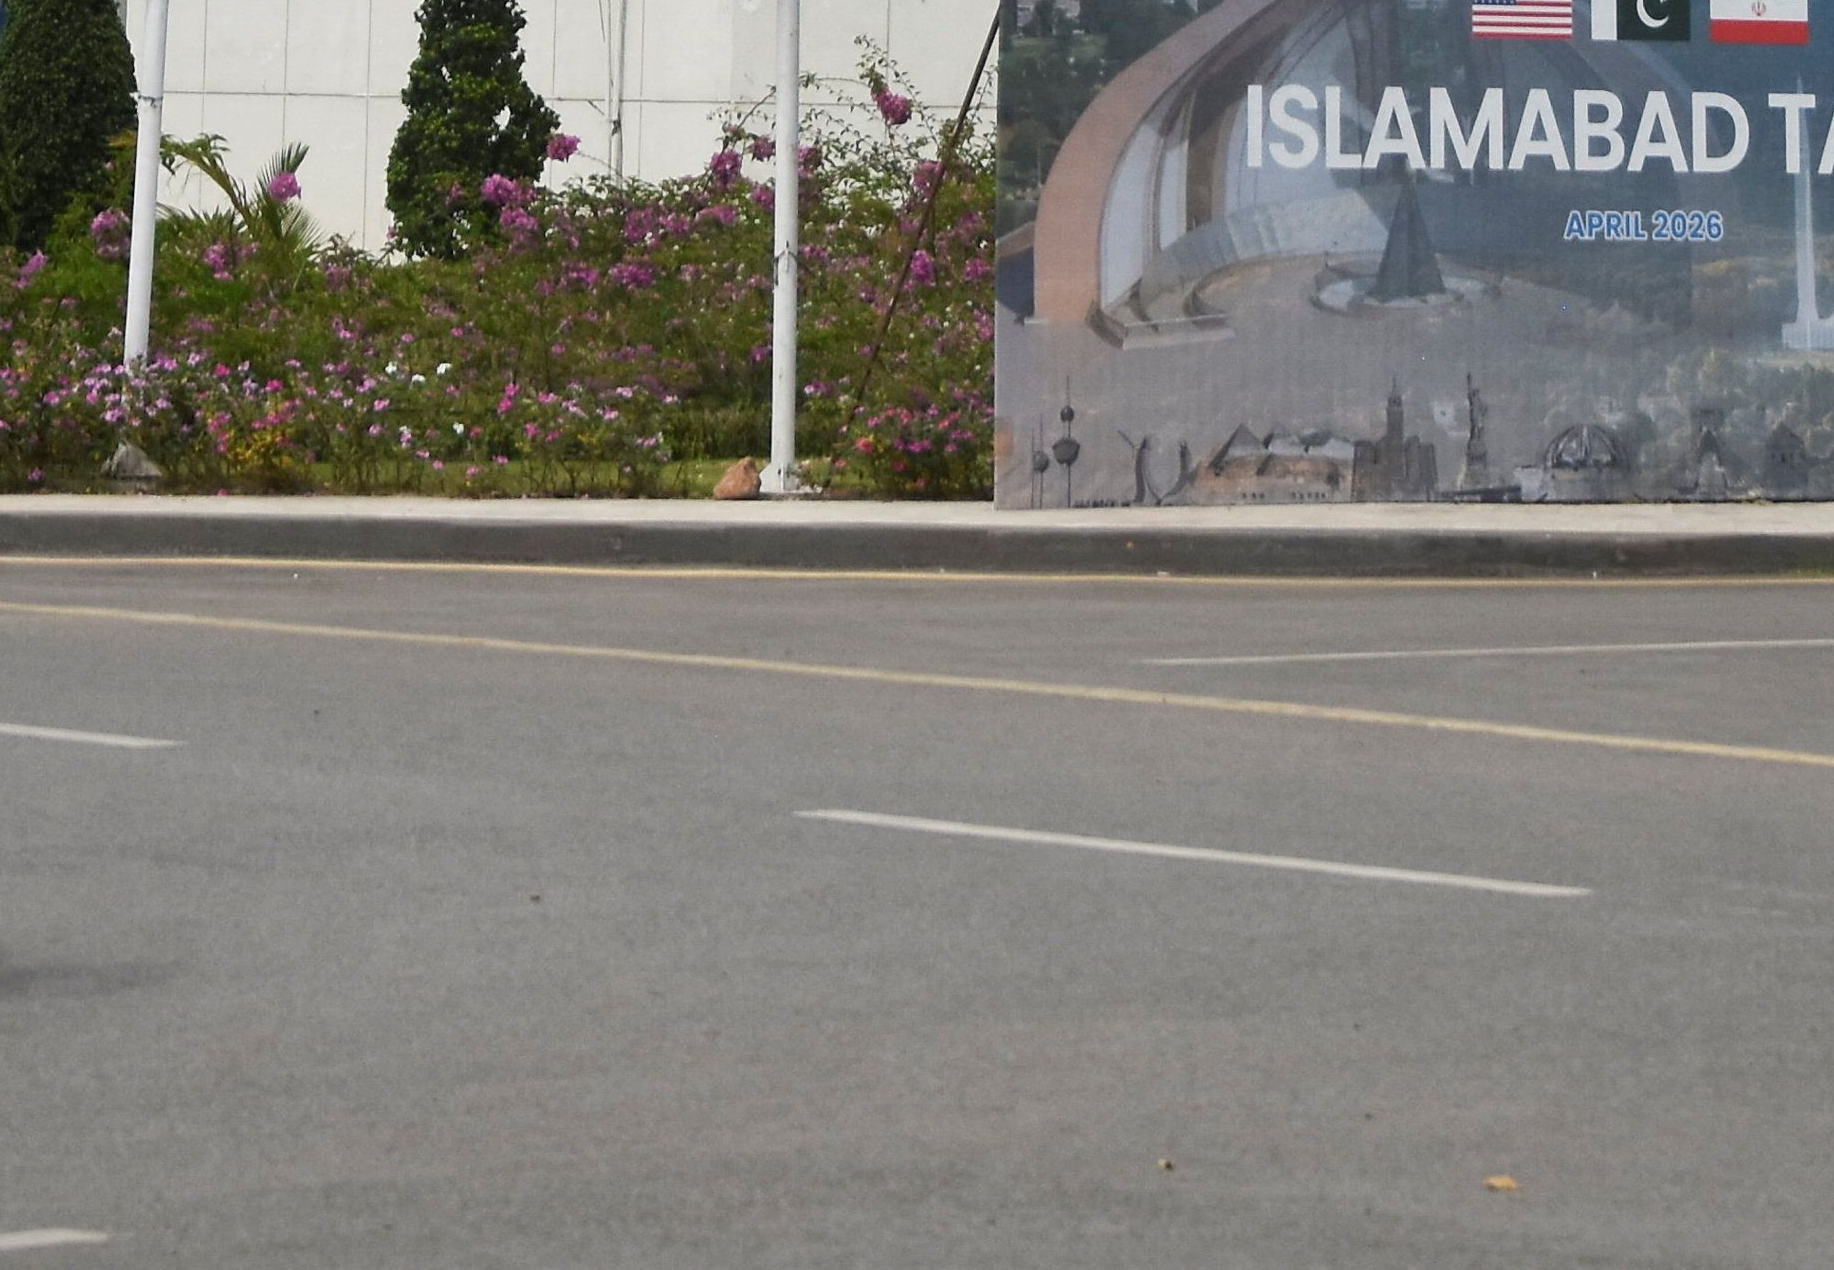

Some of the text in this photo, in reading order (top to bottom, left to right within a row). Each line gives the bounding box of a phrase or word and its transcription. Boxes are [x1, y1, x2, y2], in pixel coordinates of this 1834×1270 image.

[1246, 84, 1751, 173] ISLAMABAD
[1564, 210, 1724, 242] APRIL 2026
